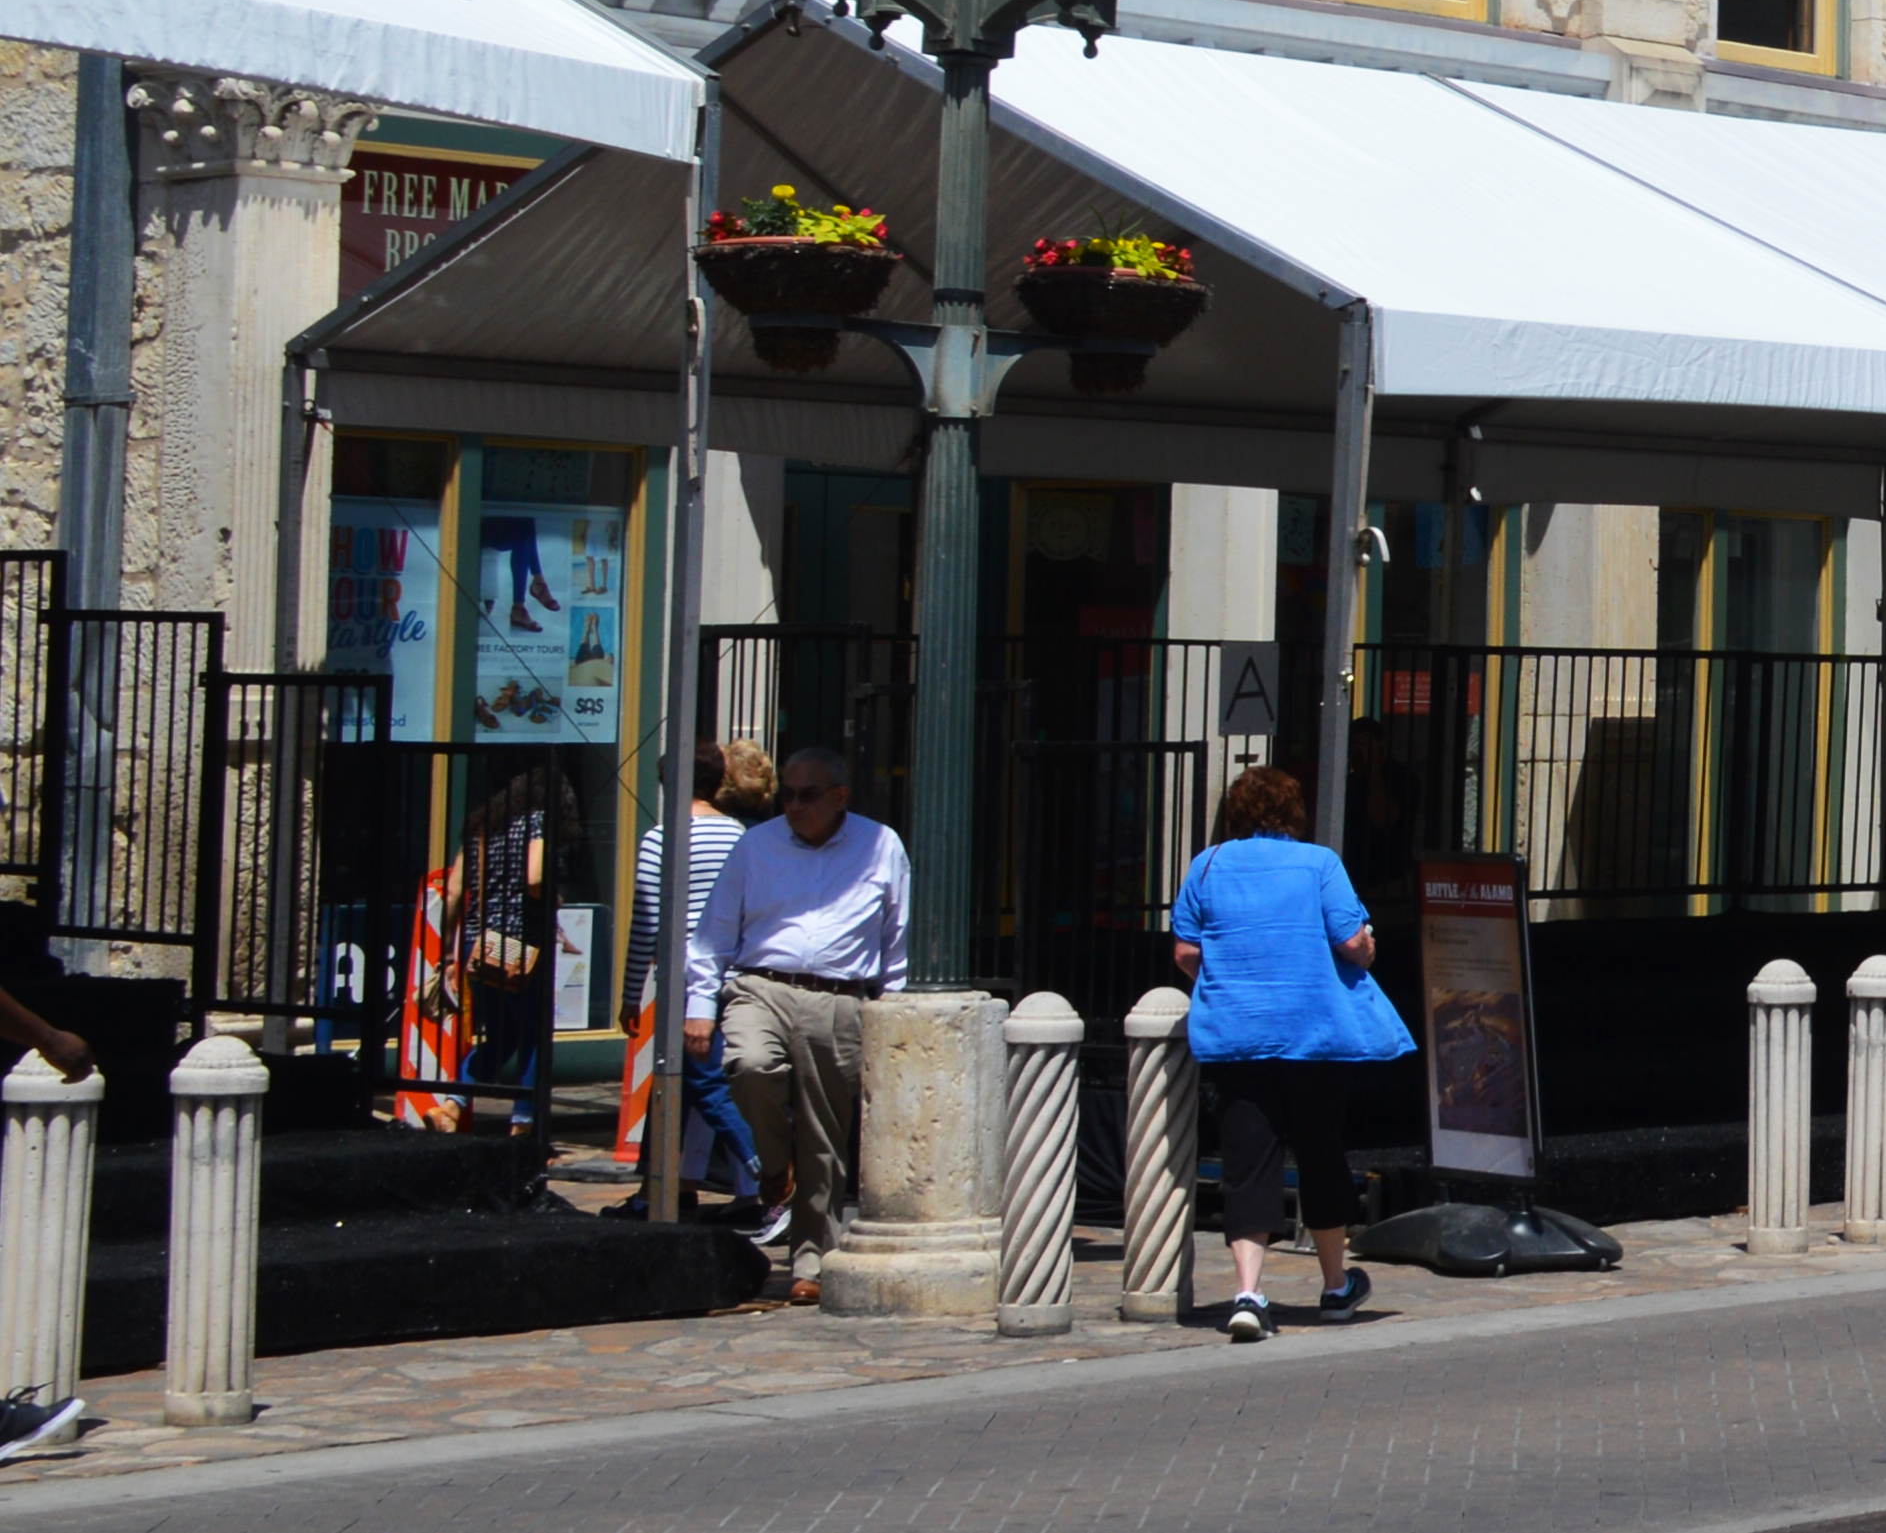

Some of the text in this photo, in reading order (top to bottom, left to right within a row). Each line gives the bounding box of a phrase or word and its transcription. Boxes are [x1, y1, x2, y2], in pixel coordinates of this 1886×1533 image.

[362, 170, 509, 221] FREE MA
[331, 526, 408, 574] HOW
[333, 576, 402, 622] OUR
[361, 610, 427, 659] style
[494, 644, 535, 653] FACTORY
[537, 645, 565, 654] TOURS
[574, 697, 605, 716] SAS
[1225, 655, 1275, 722] A
[1425, 882, 1459, 898] BATTLE
[1480, 884, 1514, 900] ALAMO
